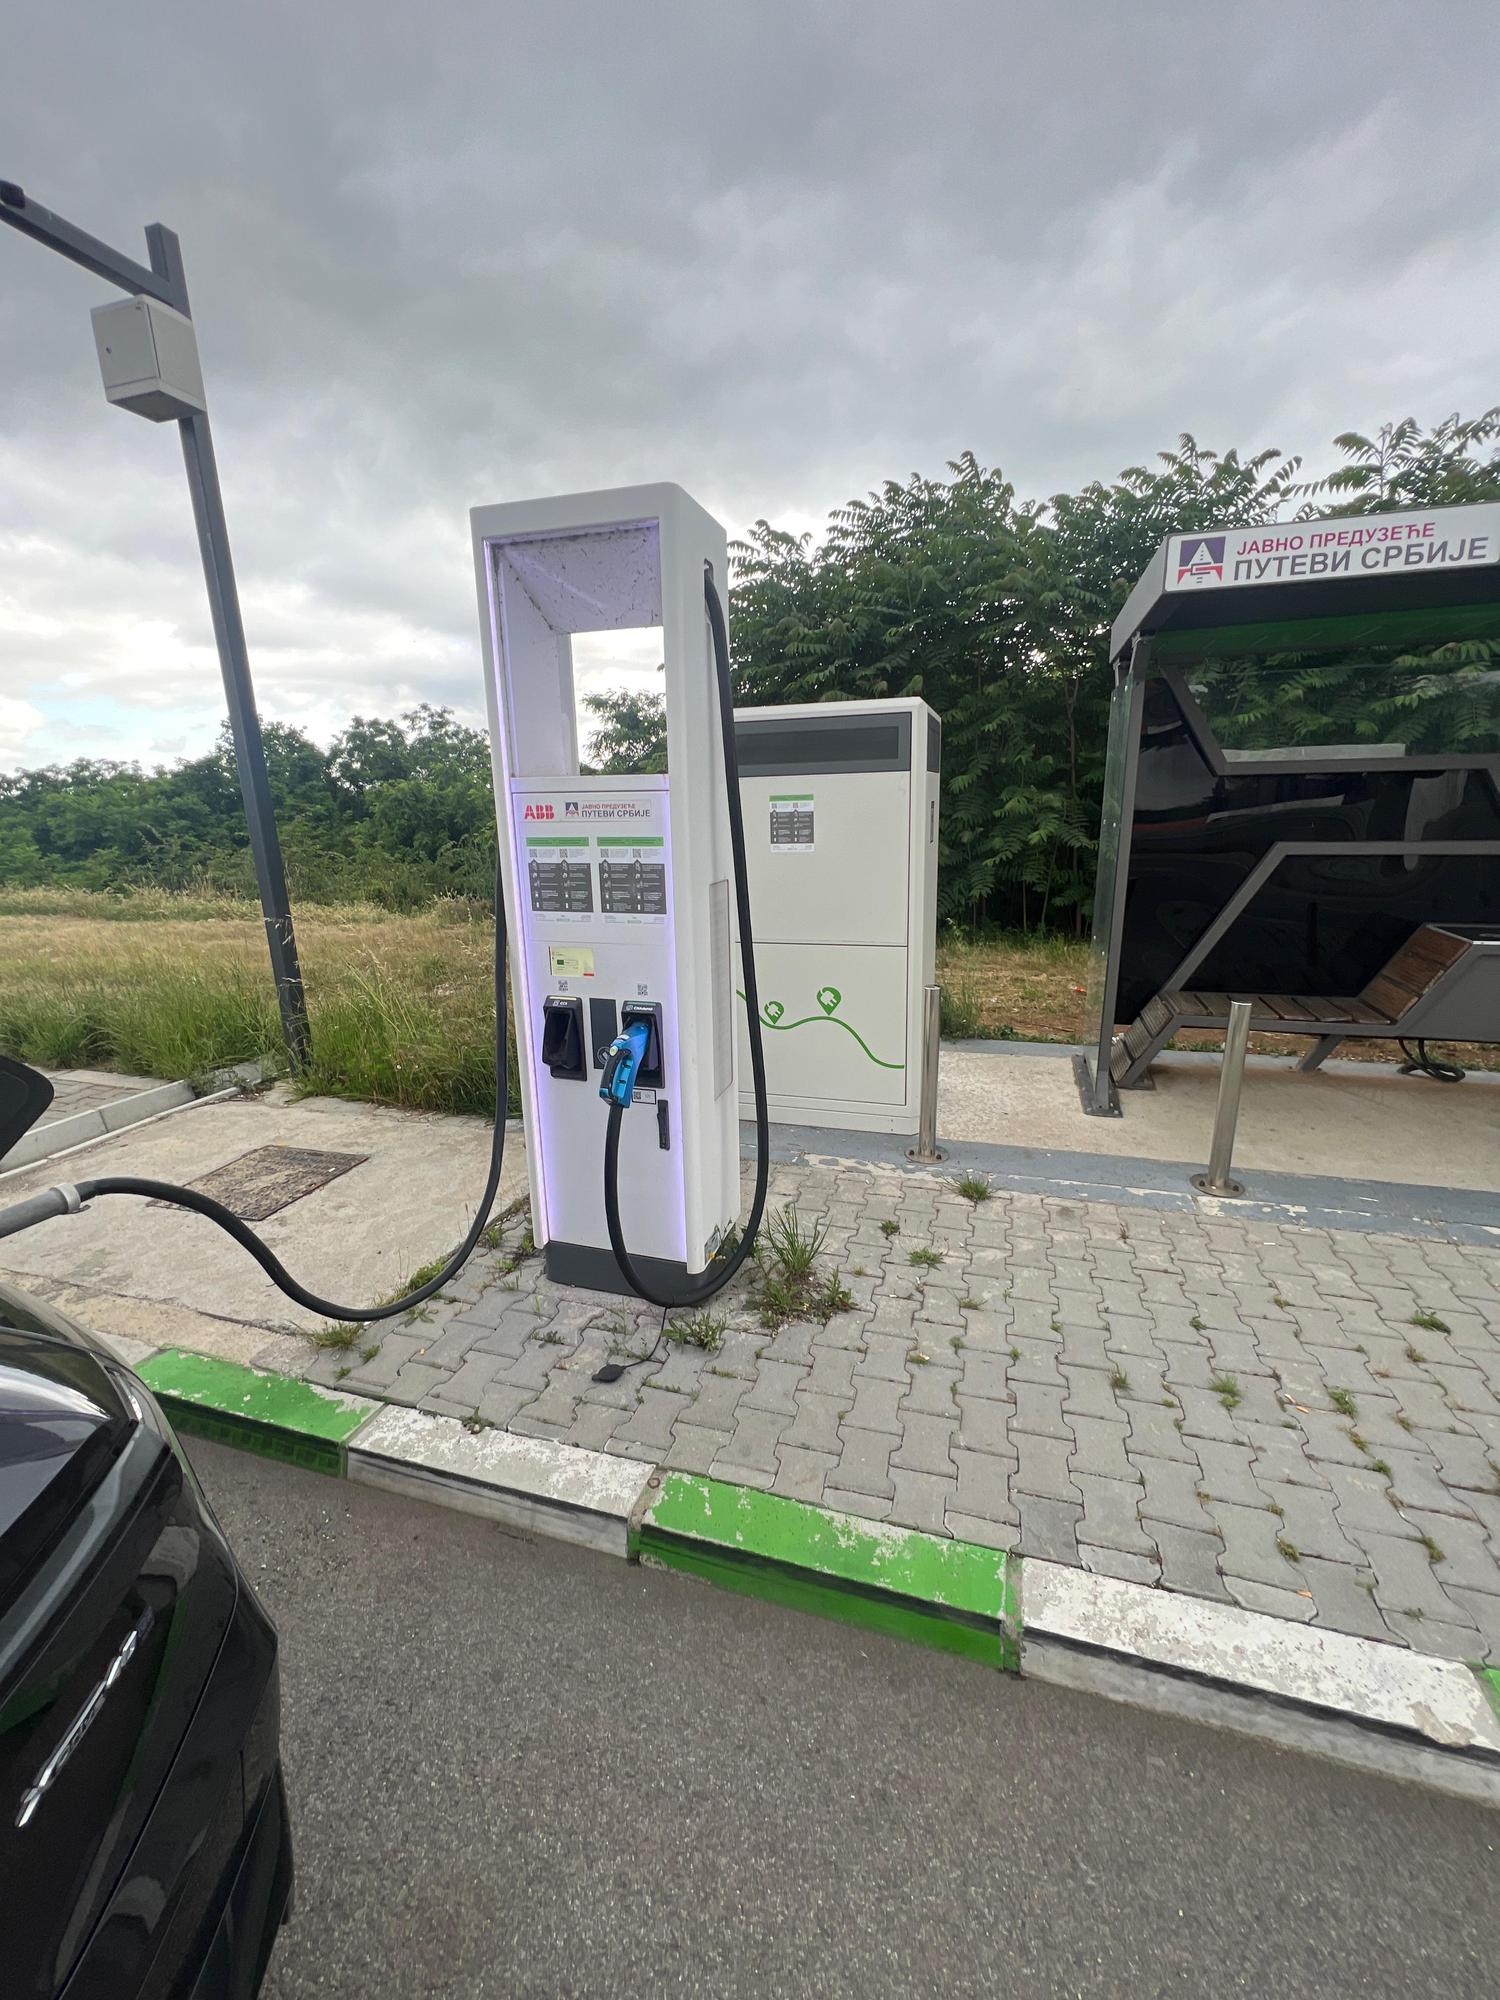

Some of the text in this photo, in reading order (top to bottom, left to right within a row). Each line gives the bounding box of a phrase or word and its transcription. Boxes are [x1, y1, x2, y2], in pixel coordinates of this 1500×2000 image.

[1237, 522, 1436, 556] ЈАВНО ПРЕДУЗЕЋЕ
[1233, 536, 1489, 581] ПУТЕВИ СРБИЈЕ
[524, 804, 555, 820] ABB
[581, 809, 651, 818] ПУТЕВИ СРБИЈЕ
